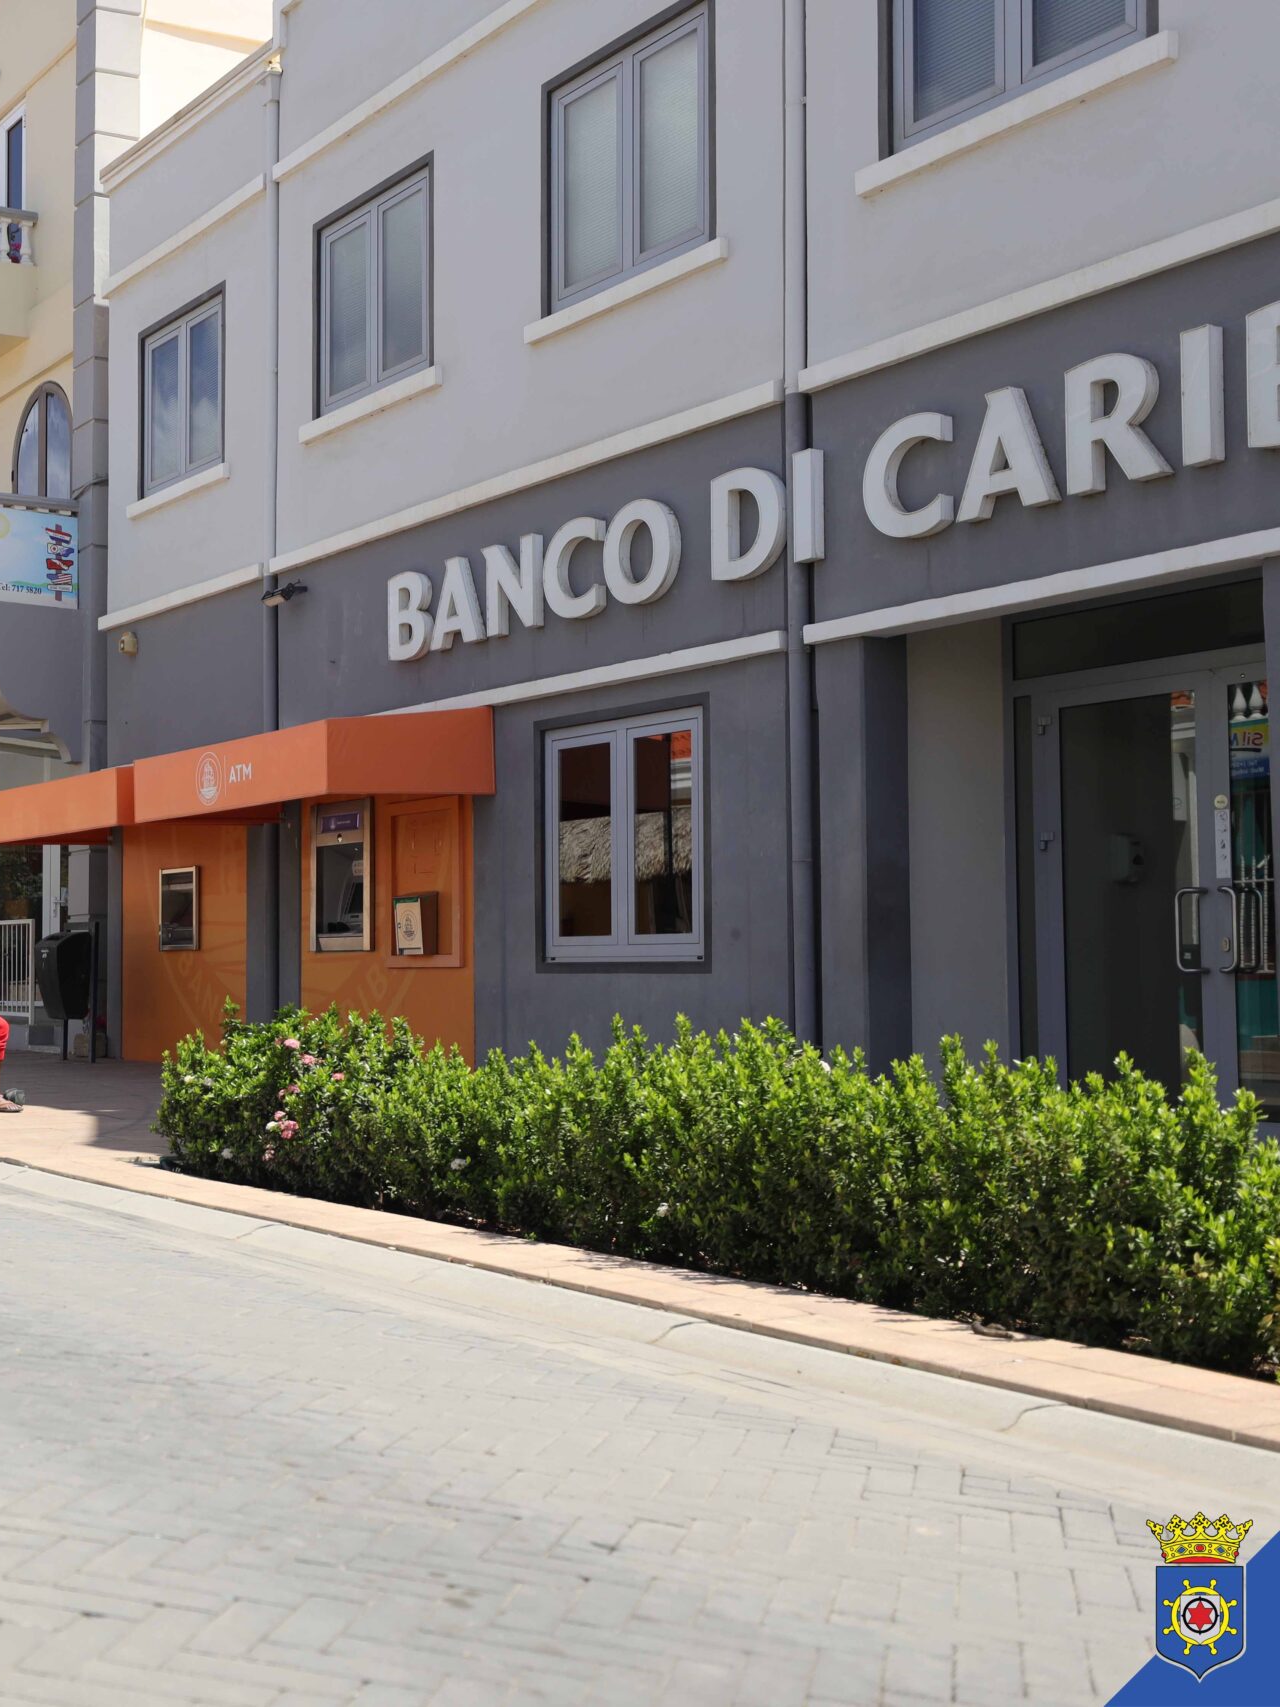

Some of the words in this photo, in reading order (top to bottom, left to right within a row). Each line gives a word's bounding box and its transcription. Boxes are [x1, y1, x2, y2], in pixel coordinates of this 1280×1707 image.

[388, 498, 682, 662] BANCO
[710, 447, 825, 583] DI
[228, 762, 253, 784] ATM
